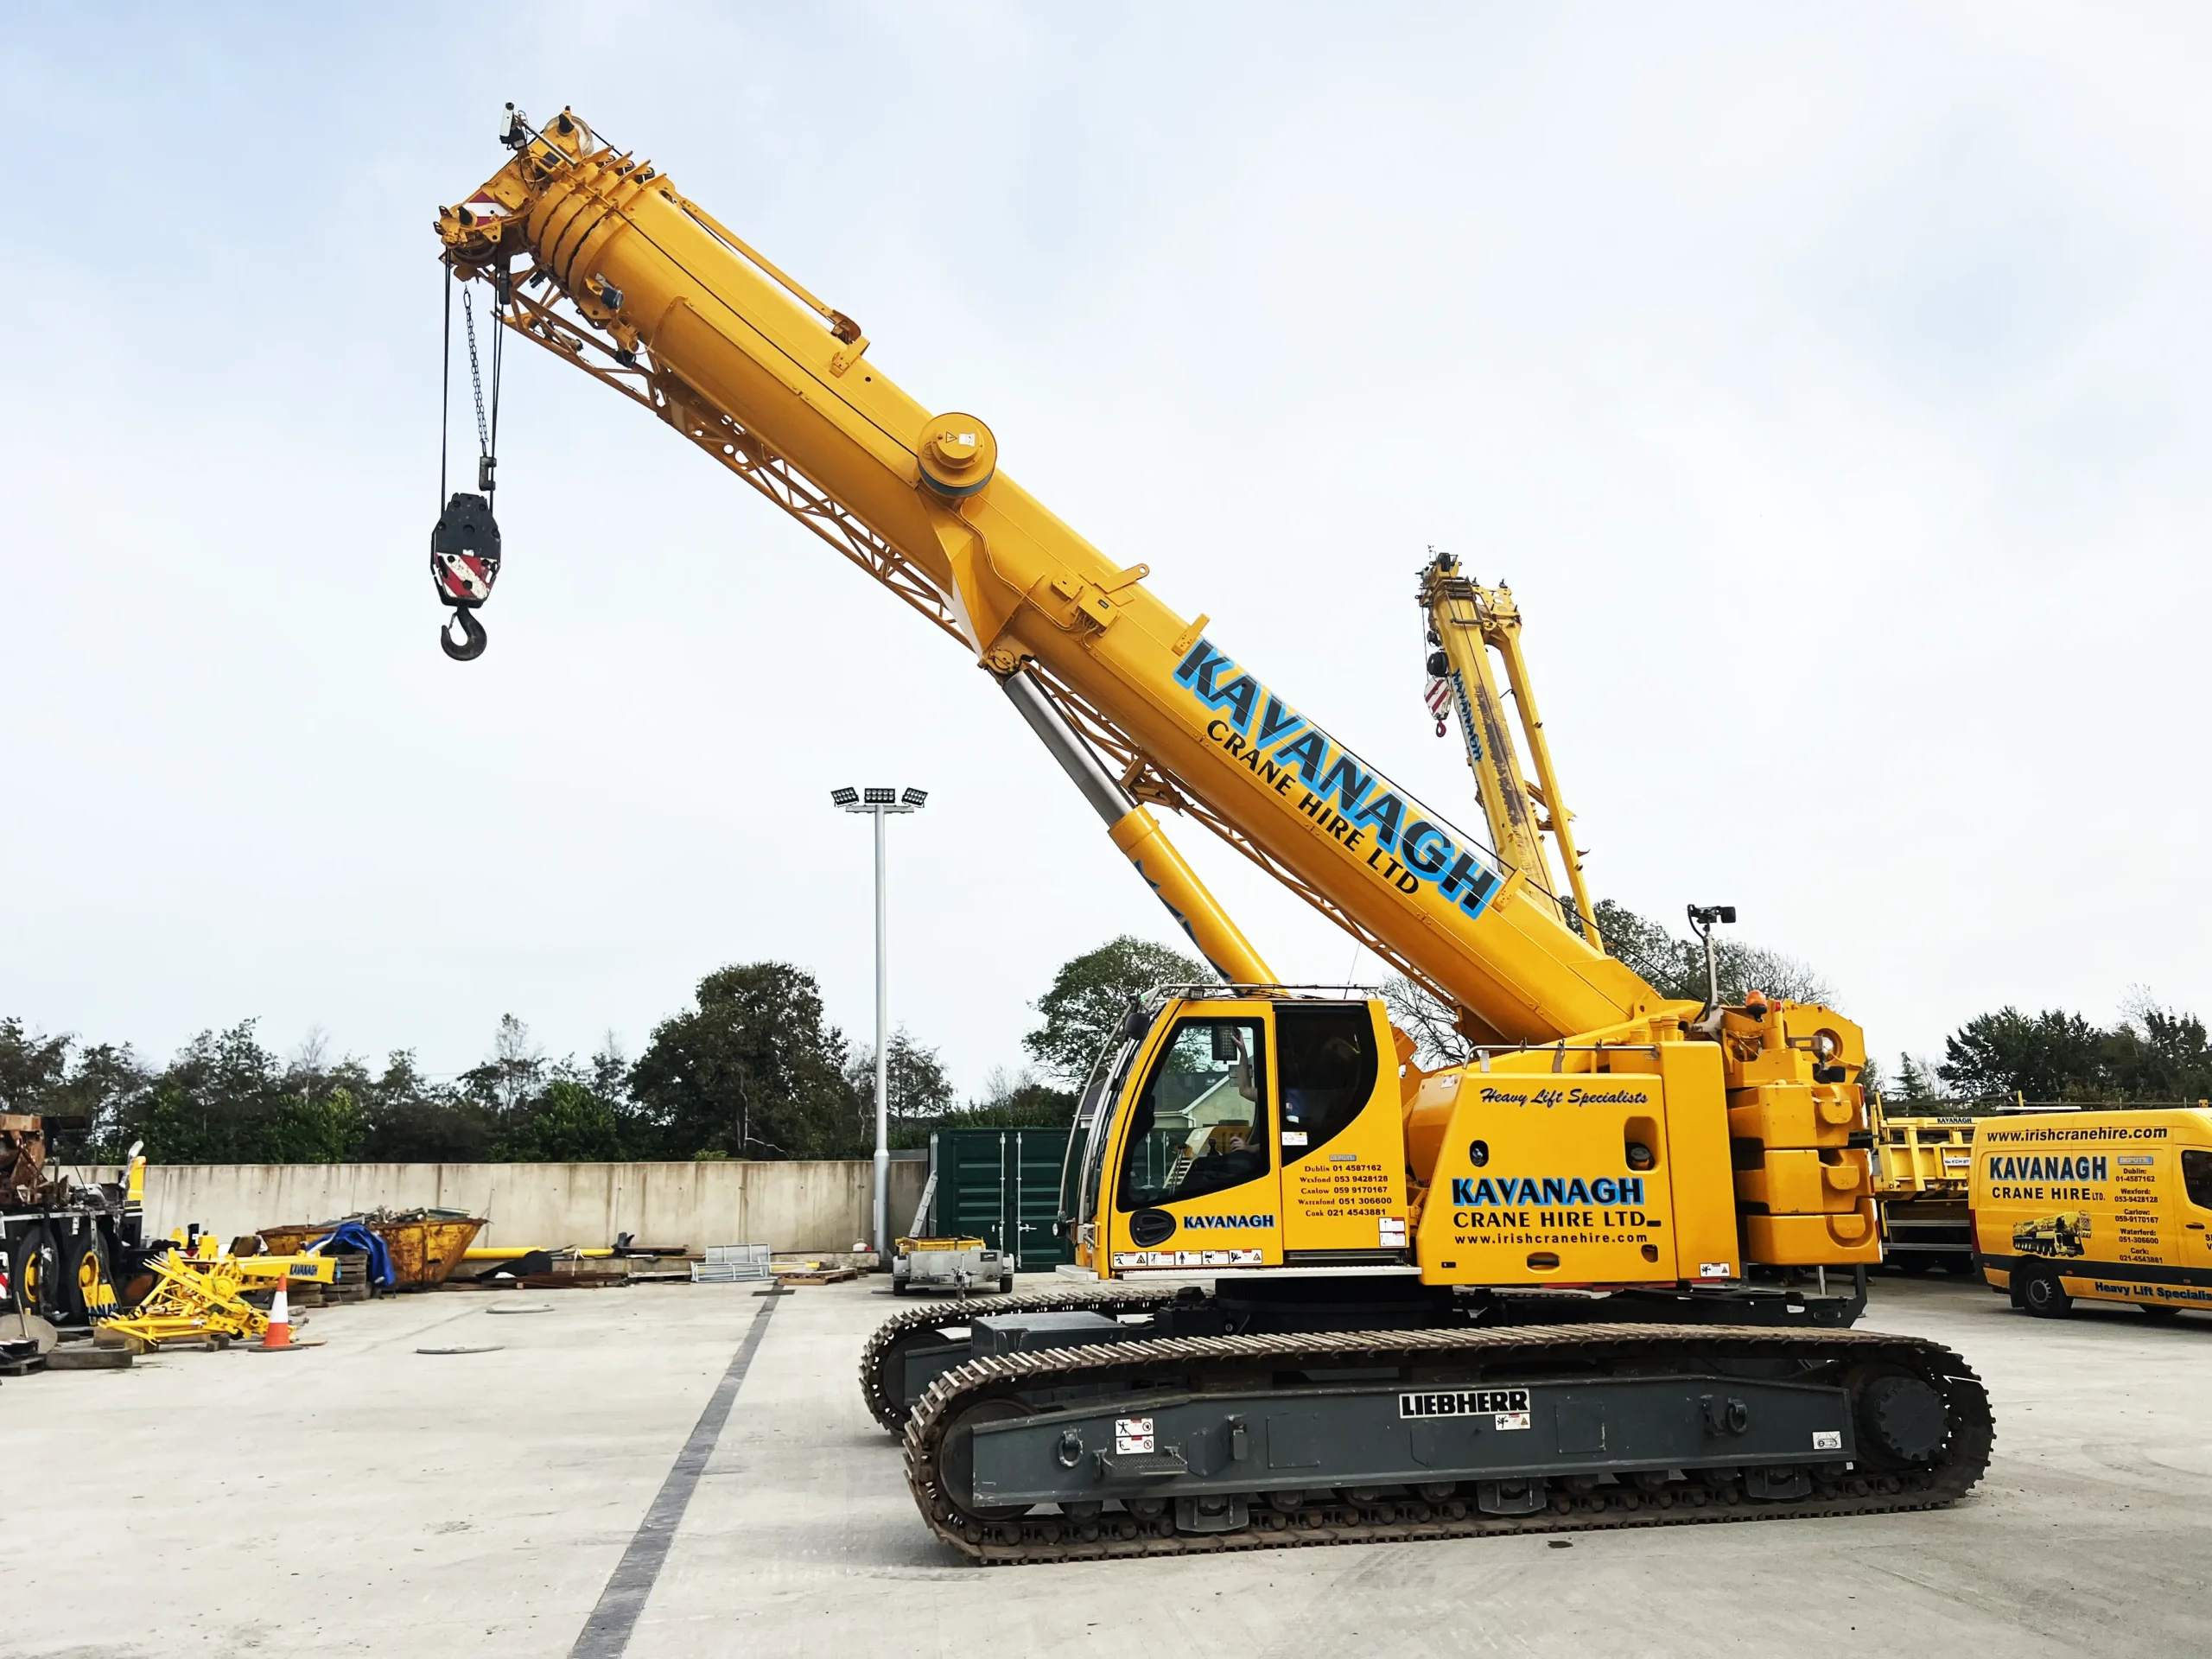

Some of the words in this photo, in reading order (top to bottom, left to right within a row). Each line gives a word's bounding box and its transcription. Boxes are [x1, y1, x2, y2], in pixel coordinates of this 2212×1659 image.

[1173, 636, 1504, 920] KAVANAGH
[1206, 718, 1296, 797] CRANE
[1297, 793, 1365, 850] HIRE
[1366, 848, 1419, 895] LTD
[1480, 1088, 1528, 1107] Heavy
[1530, 1090, 1563, 1108] Lift
[1567, 1088, 1648, 1107] Specialists
[1987, 1127, 2167, 1141] www.irishcranehire.com
[1990, 1156, 2107, 1181] KAVANAGH
[1452, 1178, 1644, 1206] KAVANAGH
[1993, 1186, 2044, 1199] CRANE
[2051, 1188, 2090, 1201] HIRE
[1184, 1215, 1274, 1229] KAVANAGH
[1453, 1211, 1529, 1228] CRANE
[1541, 1211, 1593, 1227] HIRE
[1604, 1211, 1645, 1227] LTD
[1455, 1233, 1648, 1244] www.irishcranehire.com
[2120, 1255, 2164, 1263] 021-4543881
[2095, 1282, 2130, 1295] Heavy
[2133, 1286, 2153, 1296] Lift
[1402, 1391, 1529, 1416] LIEBHERR
